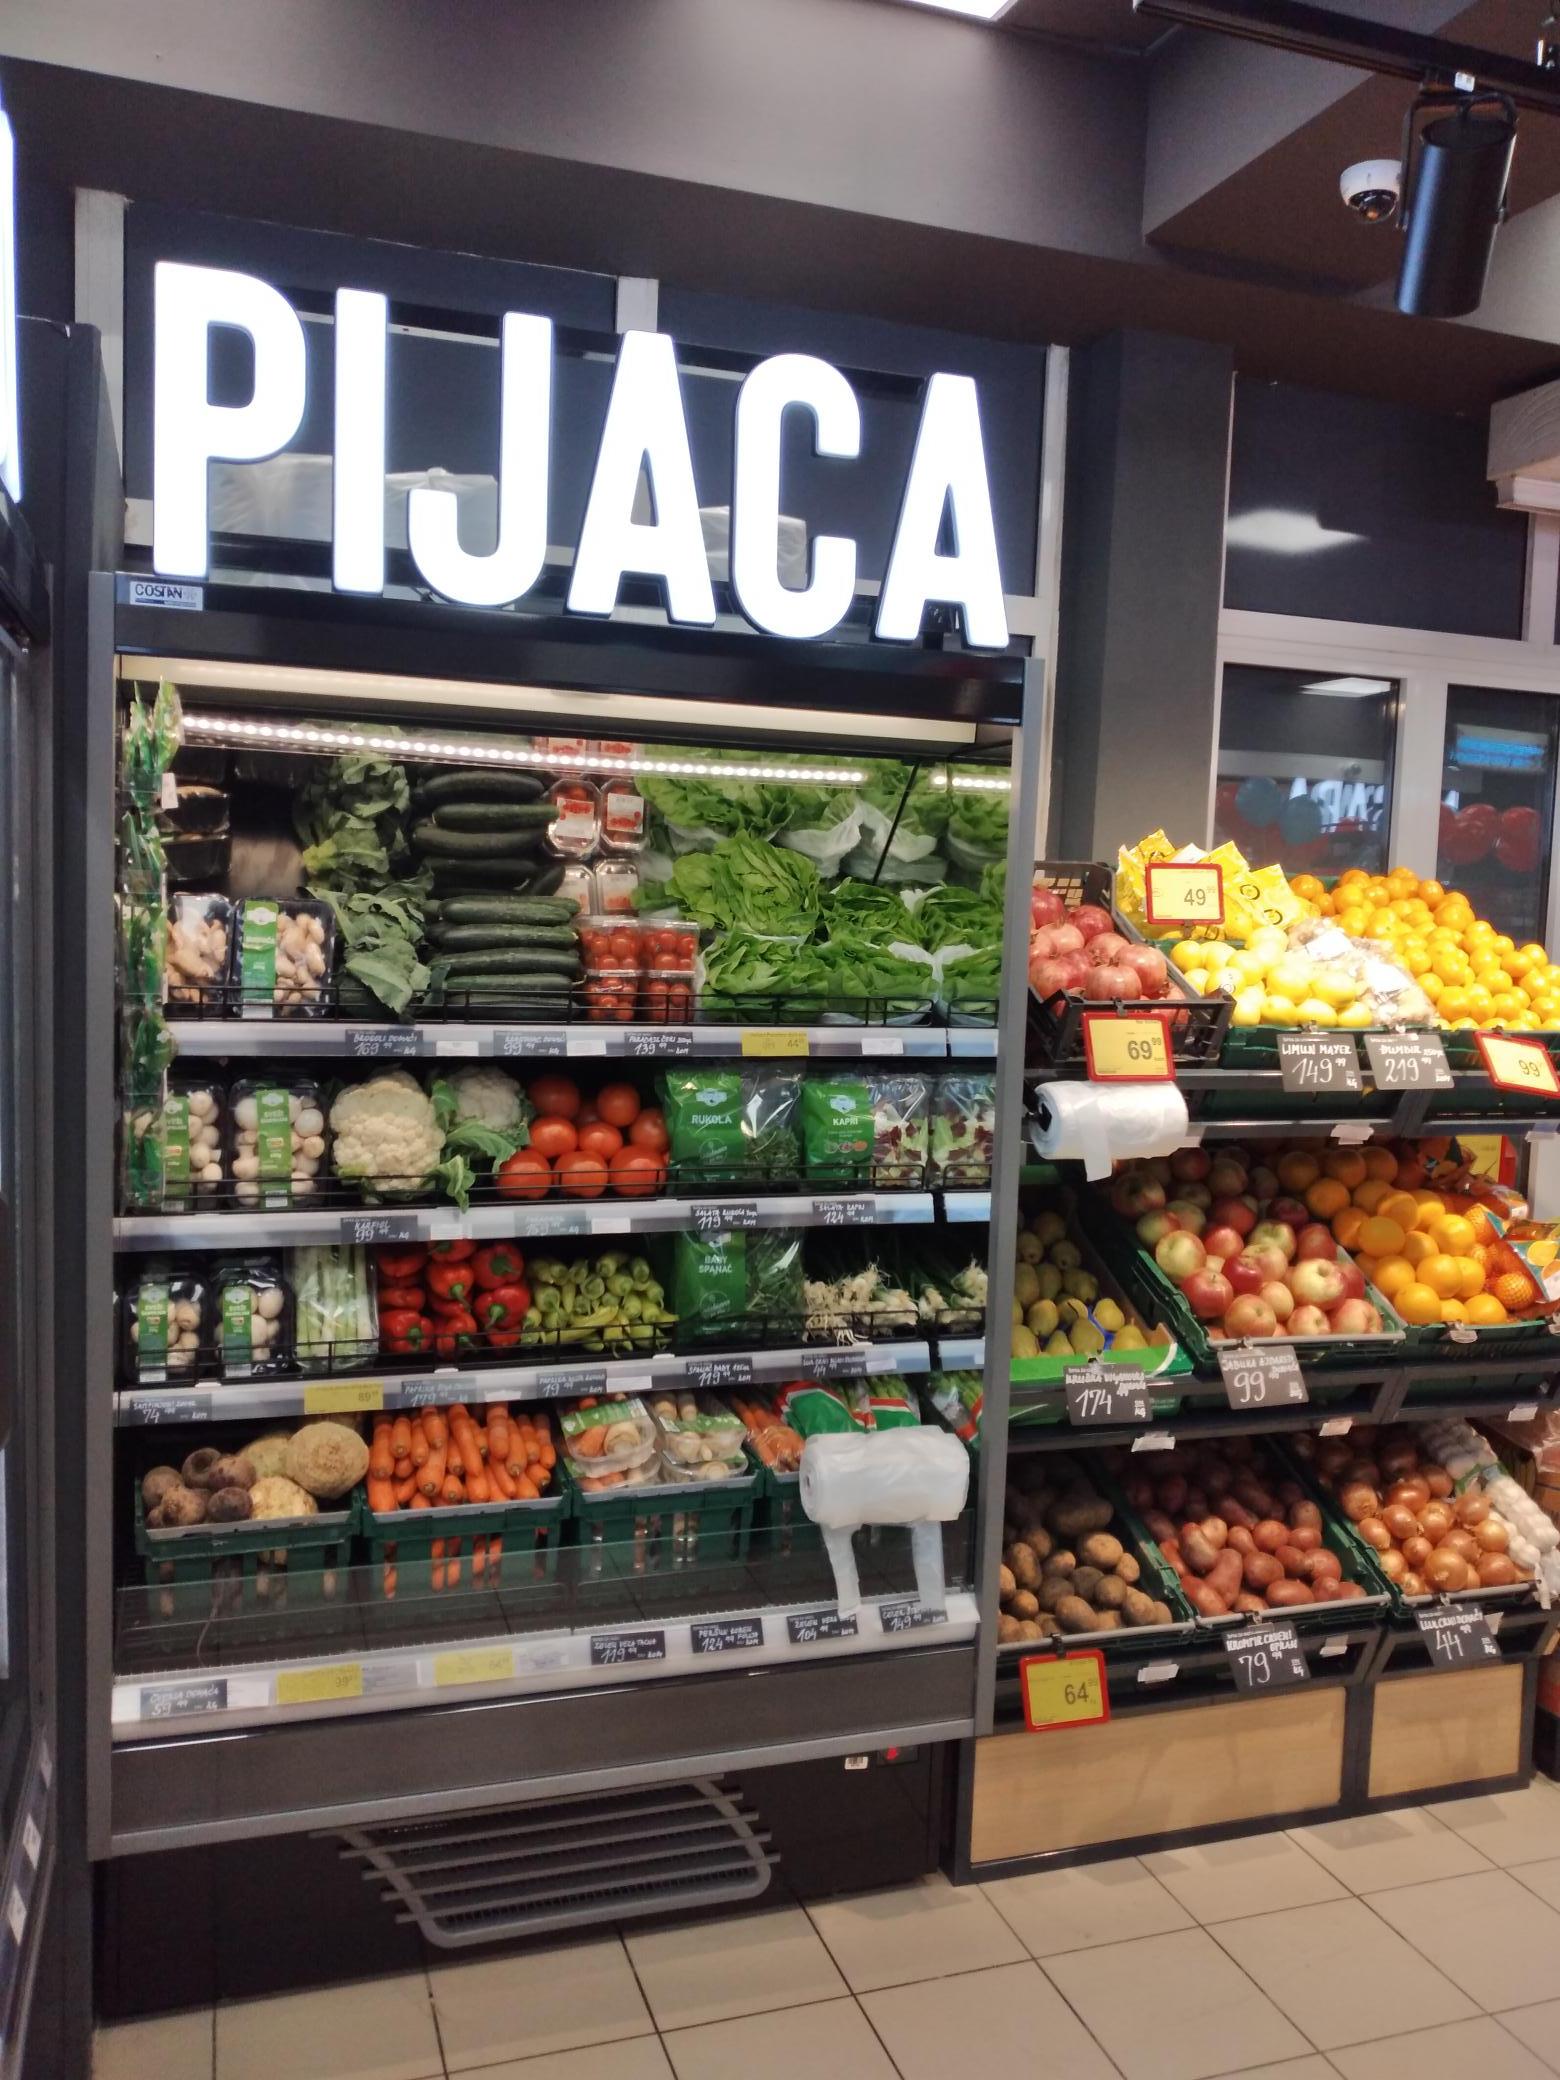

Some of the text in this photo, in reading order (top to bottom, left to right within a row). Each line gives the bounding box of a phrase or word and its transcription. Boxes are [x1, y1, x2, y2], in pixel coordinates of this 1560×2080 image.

[154, 261, 1010, 649] PIJACA
[135, 583, 183, 599] COSTAN
[1183, 888, 1206, 906] 49
[354, 1042, 379, 1056] 169
[504, 1041, 522, 1055] 99
[634, 1043, 656, 1055] 139
[1127, 1040, 1153, 1060] 69
[1281, 1044, 1353, 1056] LIMUN MAYER
[1292, 1058, 1333, 1085] 149
[1385, 1058, 1419, 1083] 219
[1518, 1060, 1541, 1077] 99
[691, 1114, 733, 1125] RUKOLA
[832, 1117, 859, 1126] KAPRI
[697, 1216, 721, 1230] 119
[823, 1212, 844, 1224] 124
[698, 1371, 721, 1387] 119
[1233, 1371, 1266, 1403] 99
[543, 1383, 560, 1397] 19
[1075, 1389, 1112, 1417] 174
[142, 1408, 160, 1424] 74
[890, 1616, 912, 1632] 149
[797, 1627, 817, 1643] 104
[702, 1637, 723, 1652] 124
[1436, 1630, 1464, 1660] 44
[600, 1647, 626, 1664] 119
[1238, 1652, 1271, 1686] 79
[1064, 1682, 1089, 1705] 64
